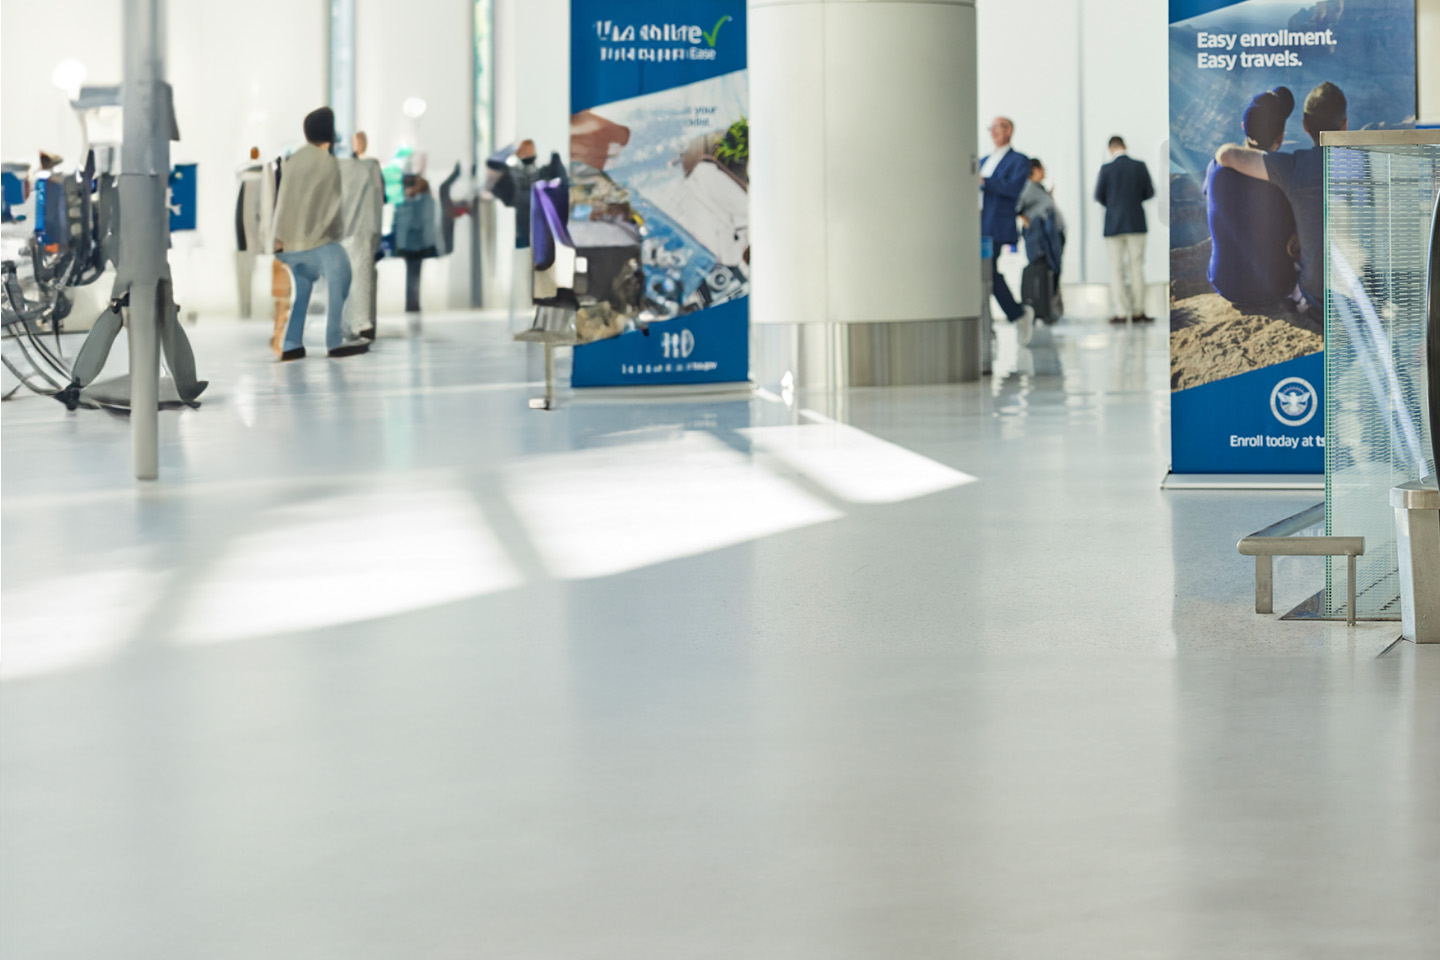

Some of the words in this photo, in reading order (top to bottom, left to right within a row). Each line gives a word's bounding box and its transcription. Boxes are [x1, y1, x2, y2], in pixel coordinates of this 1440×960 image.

[1197, 32, 1237, 51] Easy
[1240, 29, 1337, 48] enrollment.
[1197, 52, 1237, 71] Easy
[1240, 50, 1302, 68] travels.
[1229, 435, 1263, 448] Enroll
[1266, 435, 1299, 449] today
[1301, 435, 1314, 447] at
